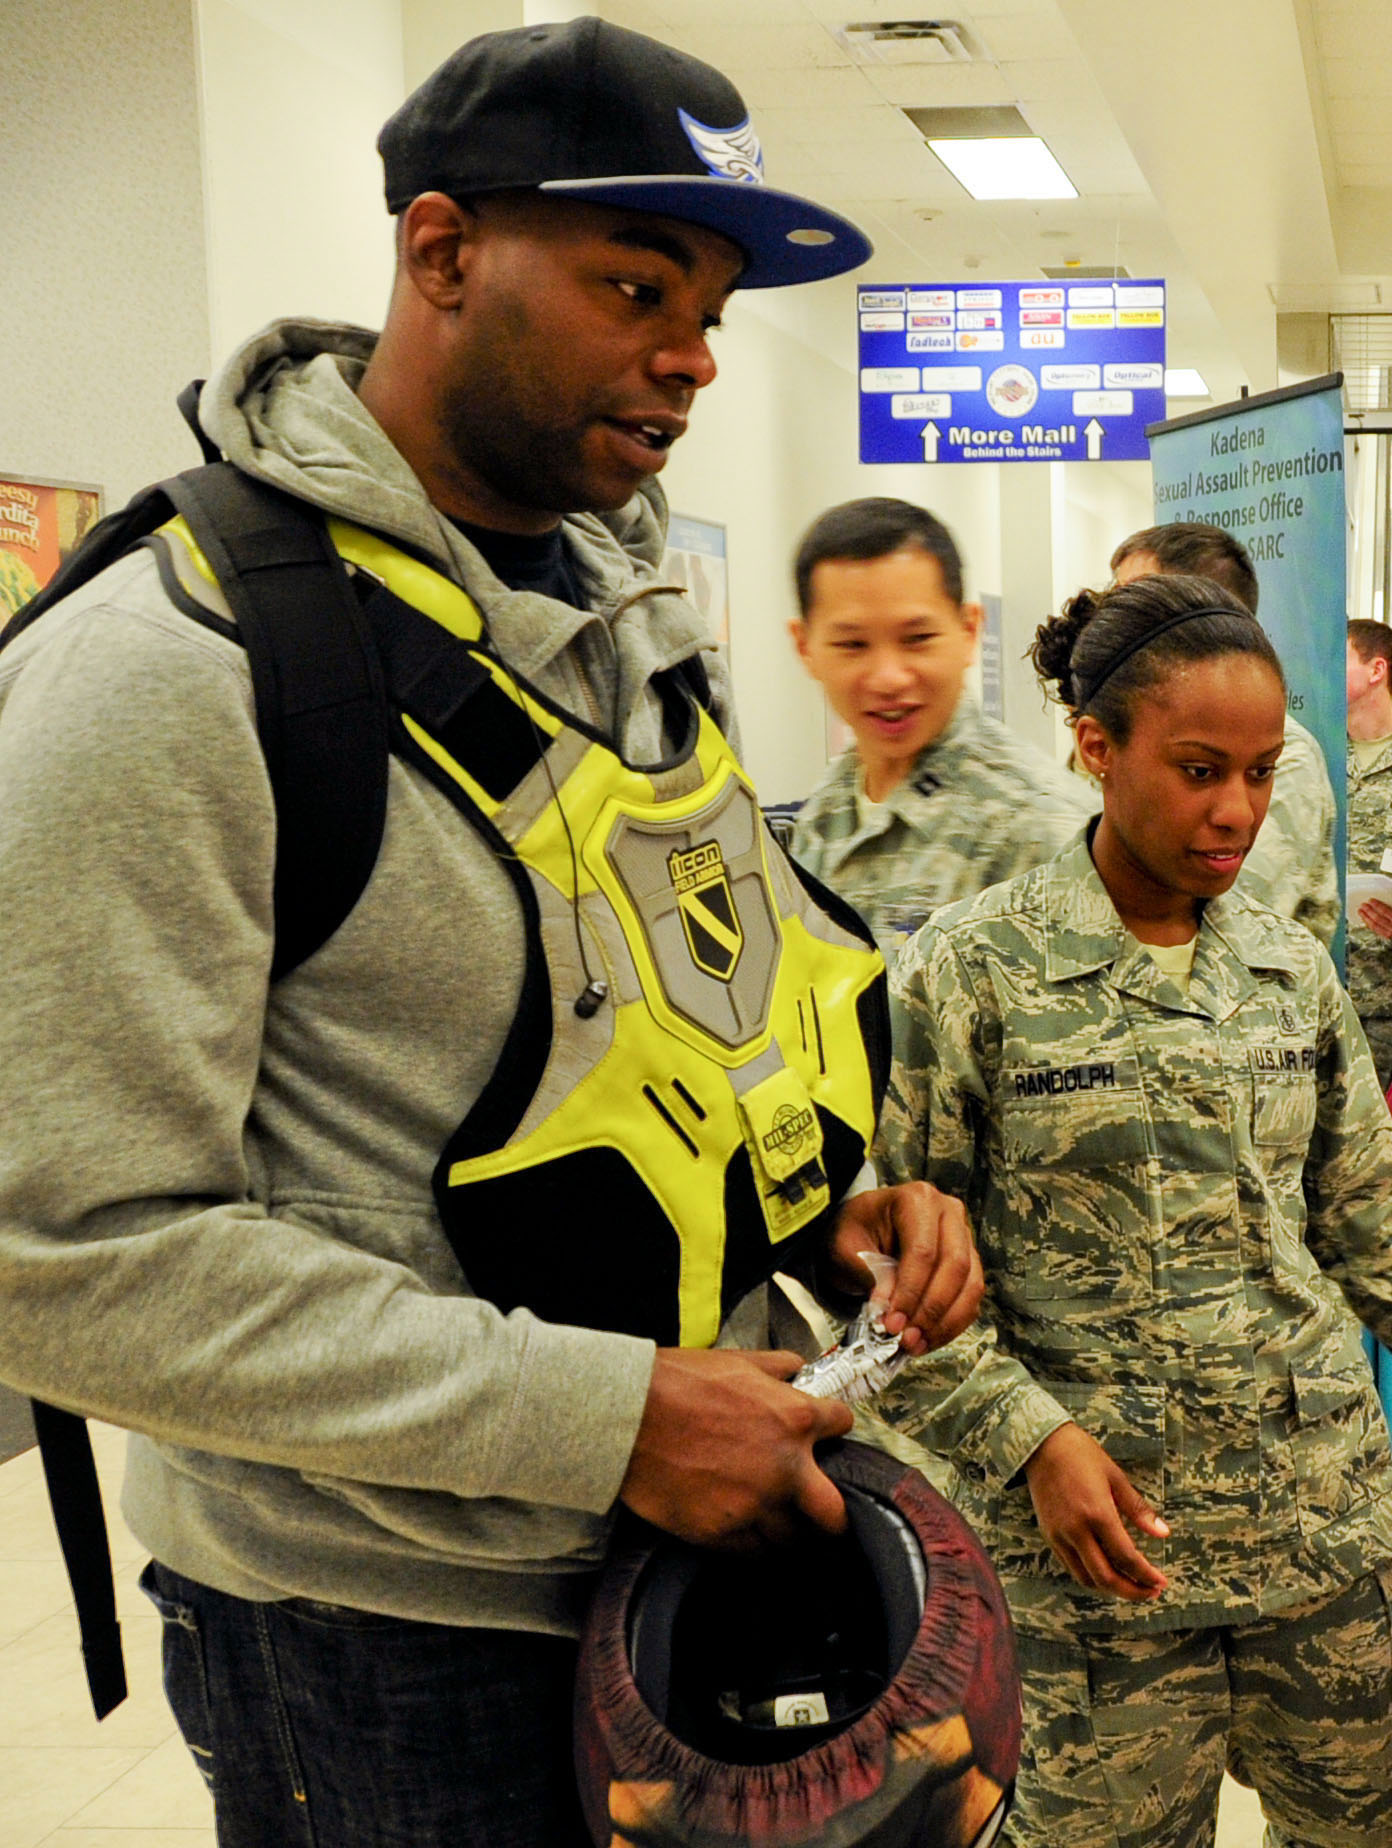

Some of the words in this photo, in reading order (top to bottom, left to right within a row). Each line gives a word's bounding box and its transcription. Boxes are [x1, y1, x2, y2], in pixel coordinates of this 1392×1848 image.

[949, 426, 1014, 445] More
[1022, 425, 1076, 444] Mall
[1210, 425, 1265, 456] Kadena
[963, 446, 1004, 458] Behind
[1005, 446, 1025, 457] the
[1026, 445, 1062, 457] Stairs
[1195, 462, 1249, 497] Assault
[1252, 449, 1343, 486] Prevention
[1259, 491, 1303, 522] Office
[1248, 532, 1285, 561] SARC
[1288, 688, 1304, 711] les
[1014, 1063, 1115, 1098] RANDOLPH
